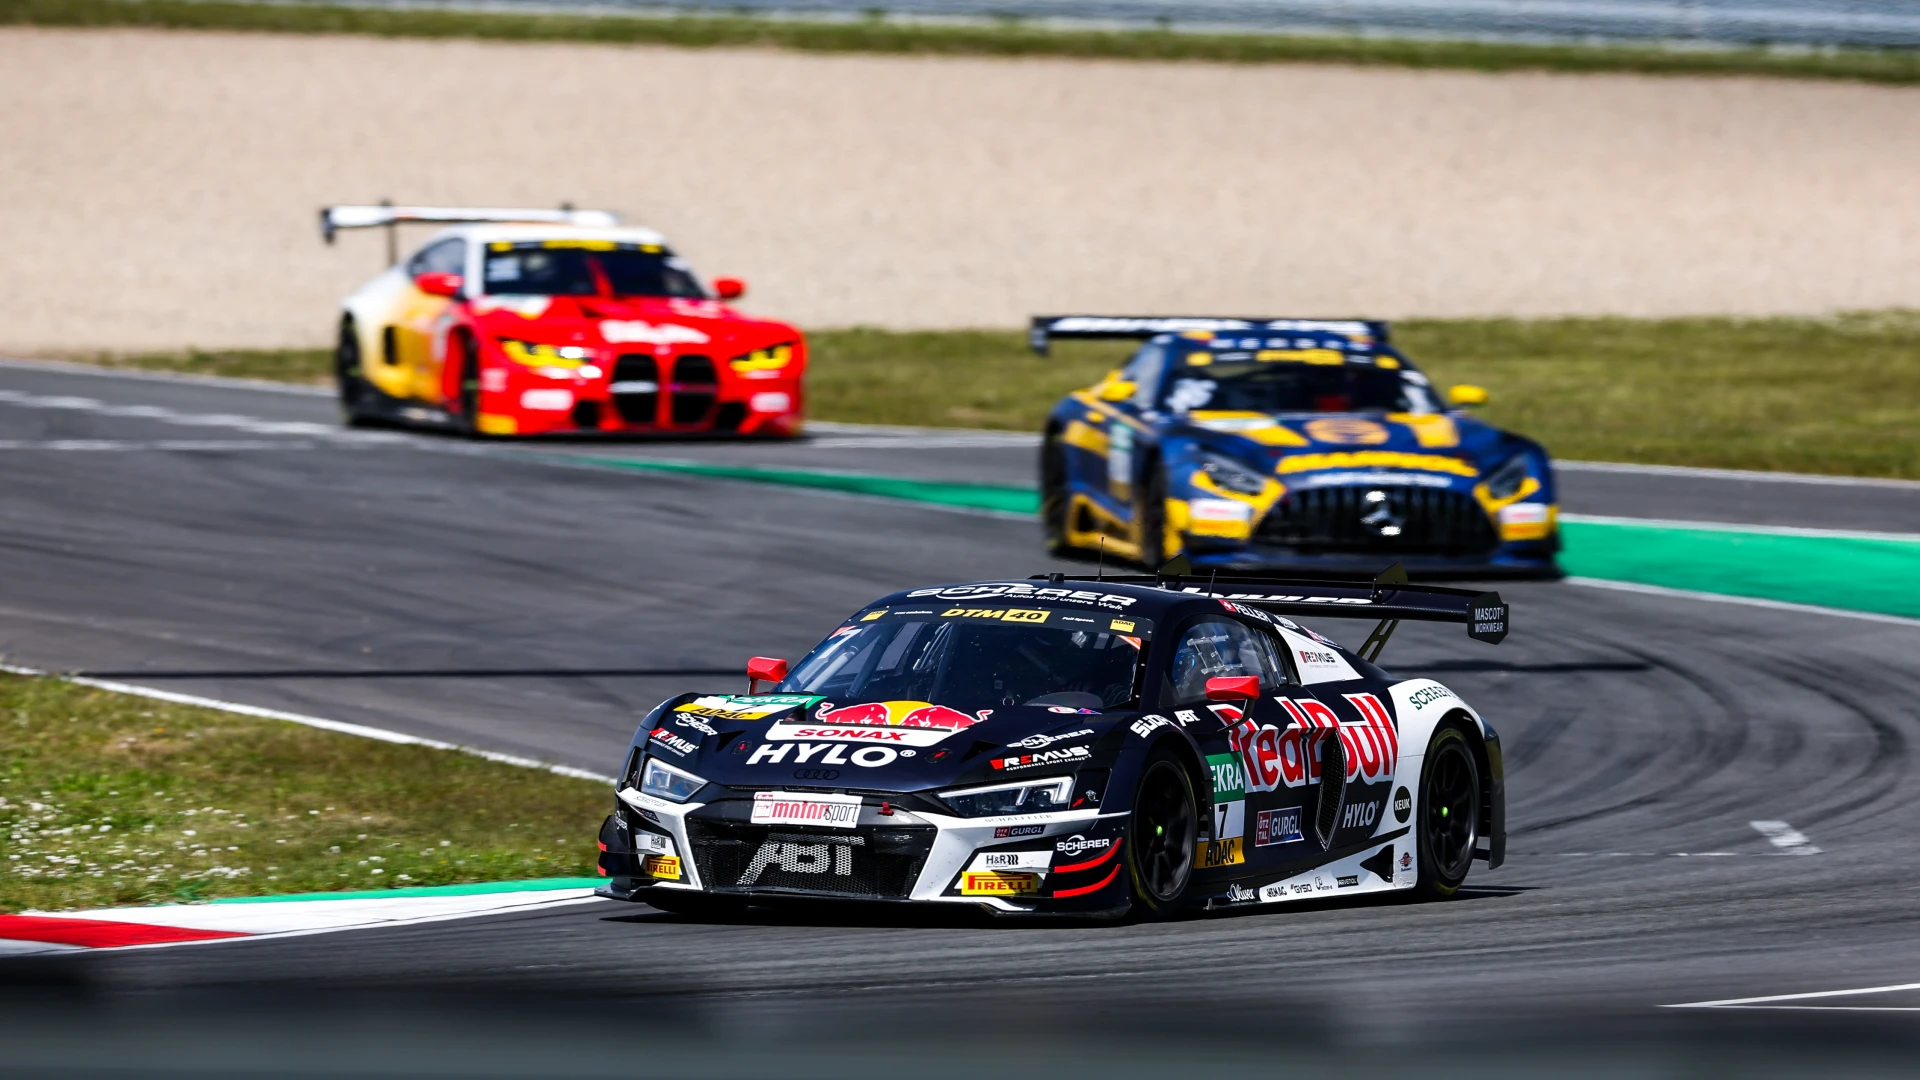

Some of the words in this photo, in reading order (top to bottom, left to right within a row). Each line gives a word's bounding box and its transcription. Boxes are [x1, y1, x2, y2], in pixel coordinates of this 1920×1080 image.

[906, 586, 1137, 606] SCHERER
[940, 608, 1005, 618] DTM
[1009, 612, 1043, 620] 40
[1474, 622, 1504, 632] WORKWEAR
[690, 707, 753, 719] ADAC
[1174, 709, 1201, 727] ABT
[794, 729, 909, 741] SONAX
[1006, 728, 1094, 748] SCHERER
[1006, 761, 1045, 771] PERFORMANCE
[1210, 762, 1244, 792] EKRA
[1394, 800, 1410, 810] KEUK
[1218, 804, 1228, 838] 7
[1272, 815, 1299, 836] GURGL
[1011, 826, 1043, 836] GURGL
[1258, 831, 1268, 840] TAL
[1057, 838, 1110, 852] SCHERER
[986, 854, 1006, 864] H&R
[968, 875, 1032, 890] PIRELLI
